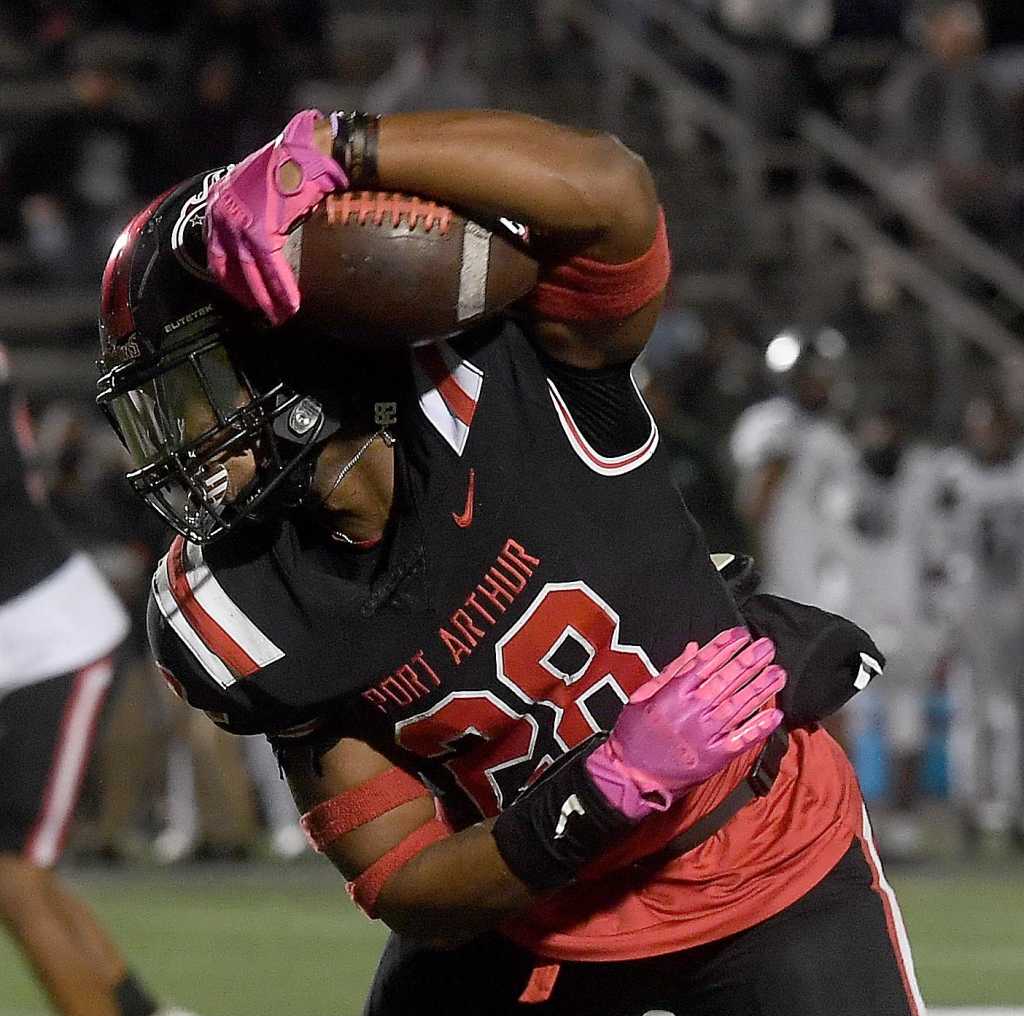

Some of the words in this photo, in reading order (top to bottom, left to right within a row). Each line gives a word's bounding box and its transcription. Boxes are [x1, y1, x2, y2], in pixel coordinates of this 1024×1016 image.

[164, 303, 213, 333] ELITETEK
[361, 649, 441, 713] PORT
[437, 538, 541, 665] ARTHUR
[394, 579, 660, 818] 28
